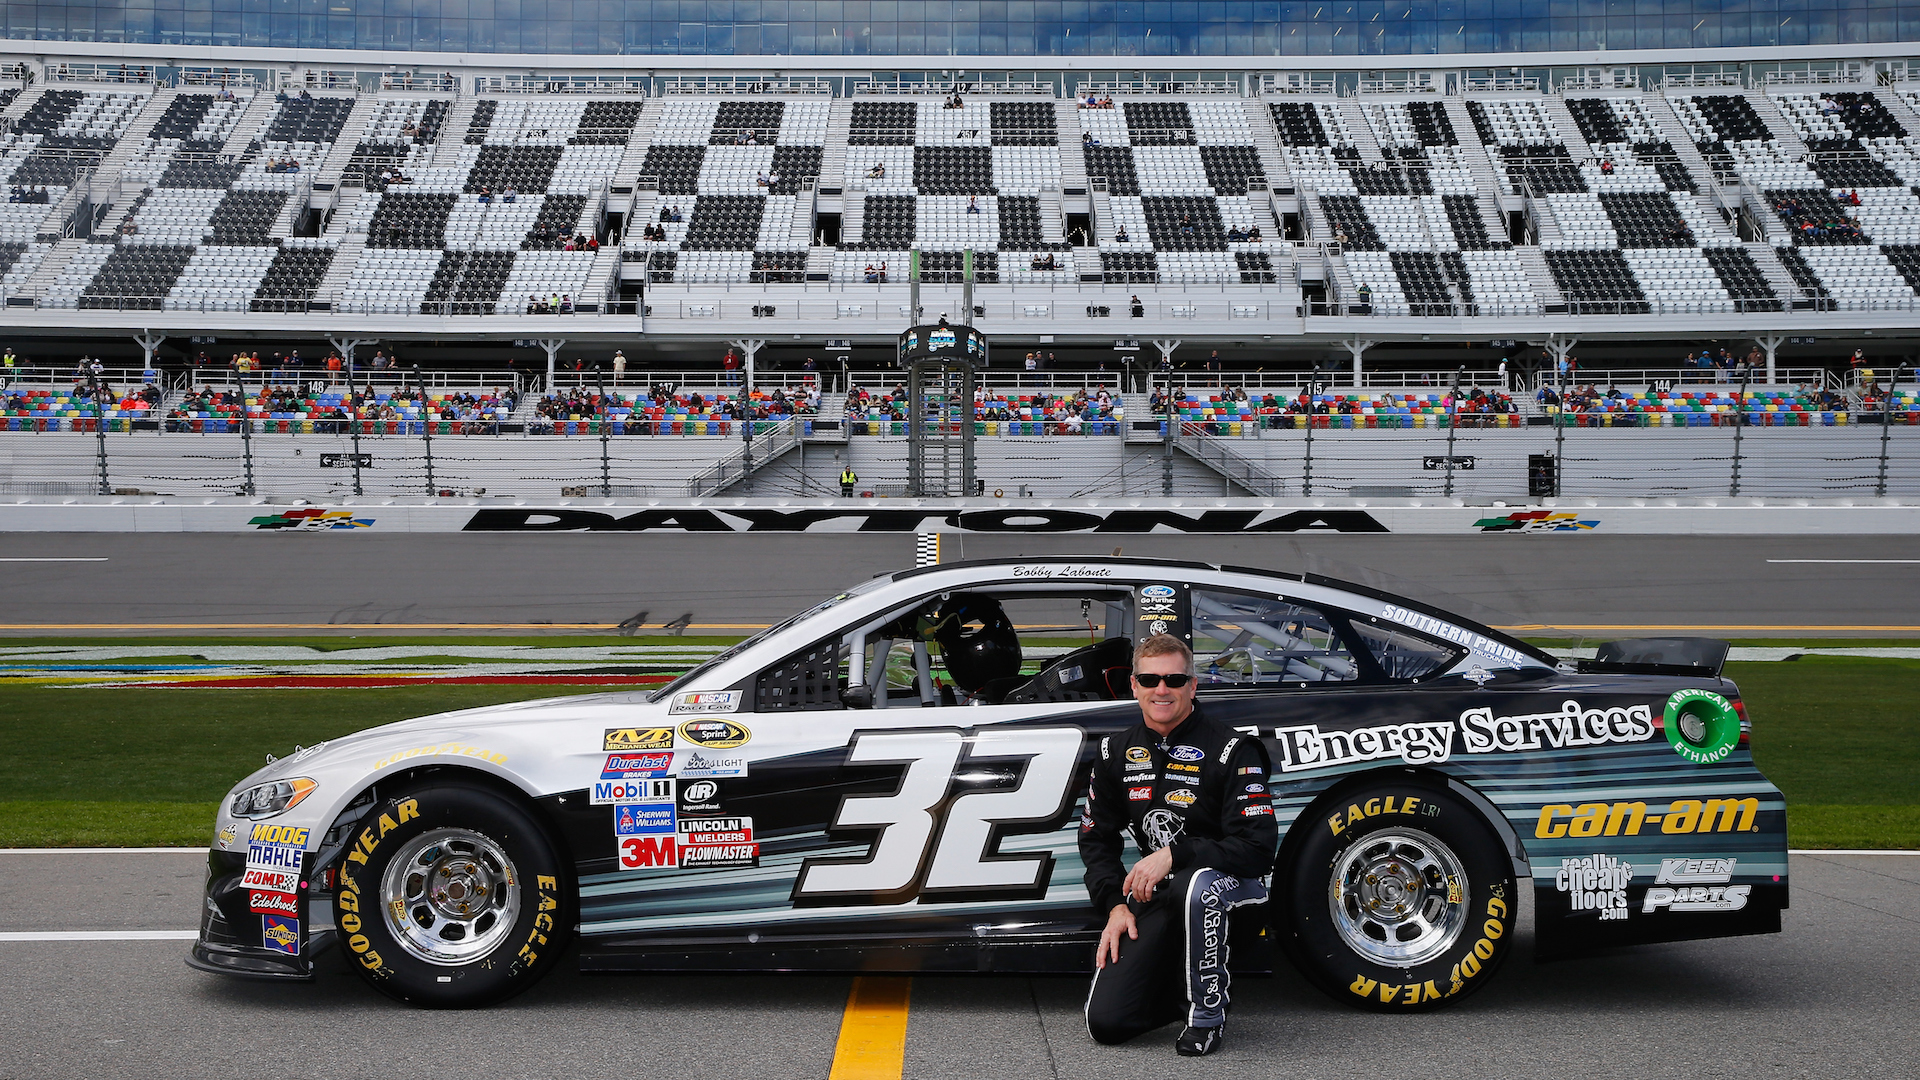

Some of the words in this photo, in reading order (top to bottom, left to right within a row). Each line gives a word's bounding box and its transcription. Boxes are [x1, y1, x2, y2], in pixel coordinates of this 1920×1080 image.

[549, 82, 559, 93] L4
[753, 82, 764, 93] L3
[956, 83, 967, 93] L2
[1173, 130, 1188, 141] 350
[215, 155, 230, 165] 354
[1372, 161, 1388, 172] 349
[308, 380, 325, 393] 148
[1654, 379, 1671, 392] 144
[461, 508, 1391, 532] DAYTONA
[1013, 566, 1053, 578] Bobby
[1057, 566, 1113, 577] Labonte
[1139, 614, 1178, 622] can-am
[1381, 603, 1473, 645] SOUTHERN
[1473, 635, 1526, 665] PRIDE
[1471, 648, 1507, 667] TRUCKING
[698, 693, 731, 703] NASCAR
[1668, 688, 1733, 714] AMERICAN
[697, 722, 726, 731] NASCAR
[701, 729, 728, 740] Sprint
[1274, 721, 1456, 772] Energy
[1460, 700, 1655, 754] Services
[605, 742, 649, 750] MECHANIX
[648, 740, 672, 749] WEAR
[1172, 746, 1200, 760] Ford
[1673, 740, 1735, 763] ETHANOL
[374, 743, 509, 770] GOODYEAR
[607, 754, 669, 770] Duralast
[686, 755, 716, 769] Coors
[716, 759, 743, 767] LIGHT
[1122, 772, 1157, 783] GOODYEAR
[595, 781, 649, 799] Mobil
[1128, 787, 1152, 800] Coca-Cola
[636, 810, 671, 819] SHERWIN
[682, 803, 705, 811] Ingersoll
[797, 726, 1085, 895] 32
[635, 818, 673, 827] WILLIAMS
[1328, 795, 1421, 837] EAGLE
[1534, 797, 1759, 839] can-am
[680, 820, 740, 833] LINCOLN
[250, 824, 310, 846] MOOG
[694, 833, 746, 843] WELDERS
[247, 845, 303, 868] MAHLE
[621, 836, 677, 868] 3M
[682, 845, 754, 867] FLOWMASTER
[1561, 854, 1618, 870] really
[244, 870, 285, 886] COMP
[1555, 866, 1628, 892] cheap
[1654, 858, 1737, 884] KEEN
[250, 892, 298, 914] Edelbrock
[1570, 890, 1628, 911] floors
[1642, 885, 1751, 913] PARTS
[518, 874, 557, 967] EAGLE
[1598, 908, 1629, 920] .com
[267, 929, 297, 942] SUNOCO
[1199, 907, 1222, 971] Energy
[1200, 972, 1222, 1008] C&J
